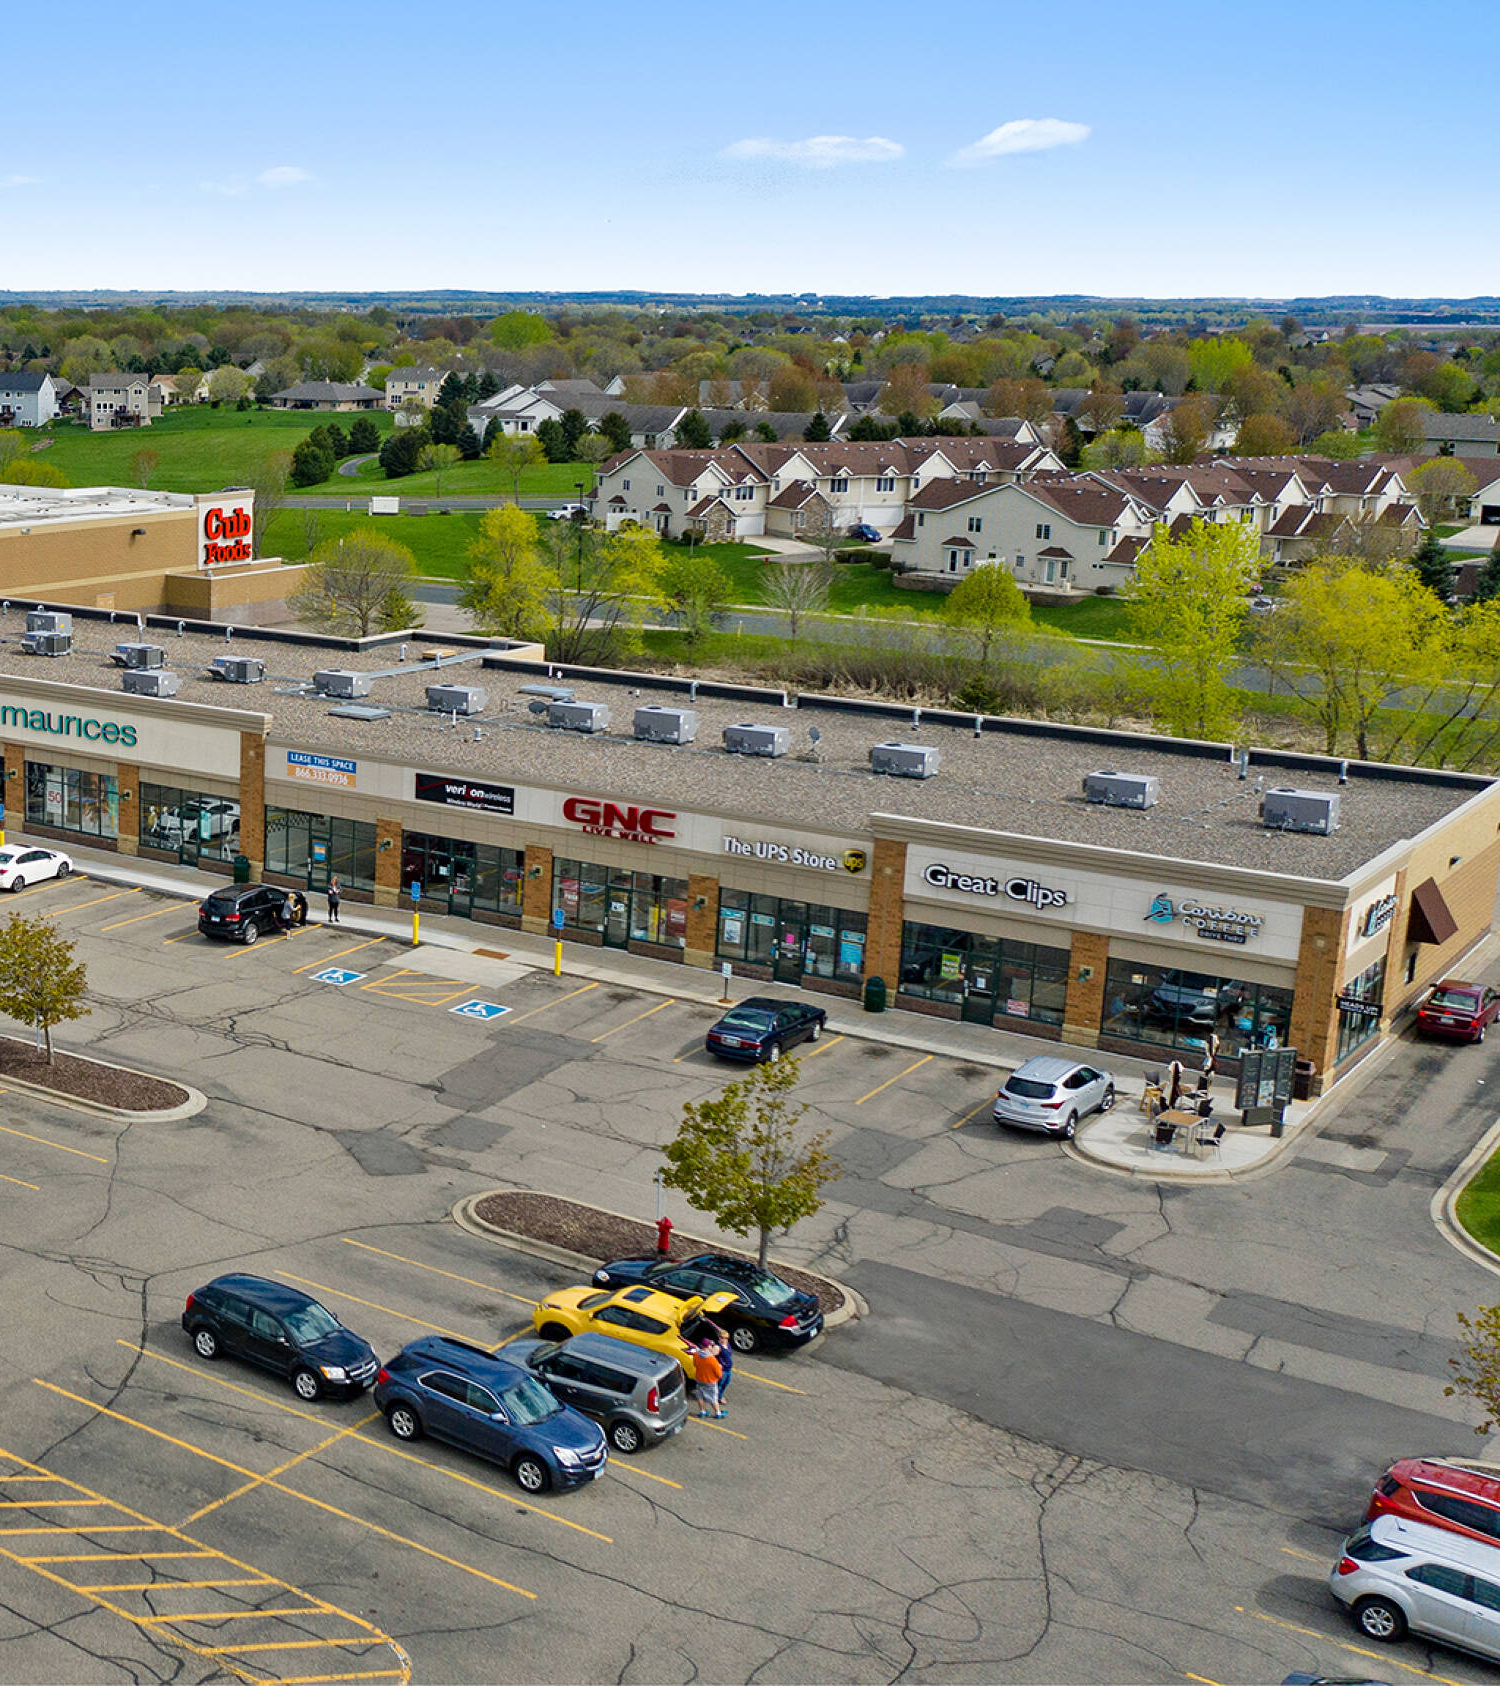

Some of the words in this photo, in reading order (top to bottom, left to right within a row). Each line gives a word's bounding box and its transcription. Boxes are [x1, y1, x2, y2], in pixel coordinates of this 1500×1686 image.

[204, 507, 251, 540] Cub
[204, 539, 251, 564] Foods
[0, 705, 137, 747] maurices
[291, 753, 312, 764] LEASE
[313, 757, 330, 766] THIS
[332, 759, 355, 771] SPACE
[563, 797, 677, 838] GNC
[723, 835, 751, 856] The
[756, 841, 788, 862] UPS
[793, 848, 837, 871] Store
[925, 864, 998, 896] Great
[1004, 877, 1066, 909] Clips
[1179, 899, 1264, 926] Caribou
[1182, 916, 1260, 937] COFFEE
